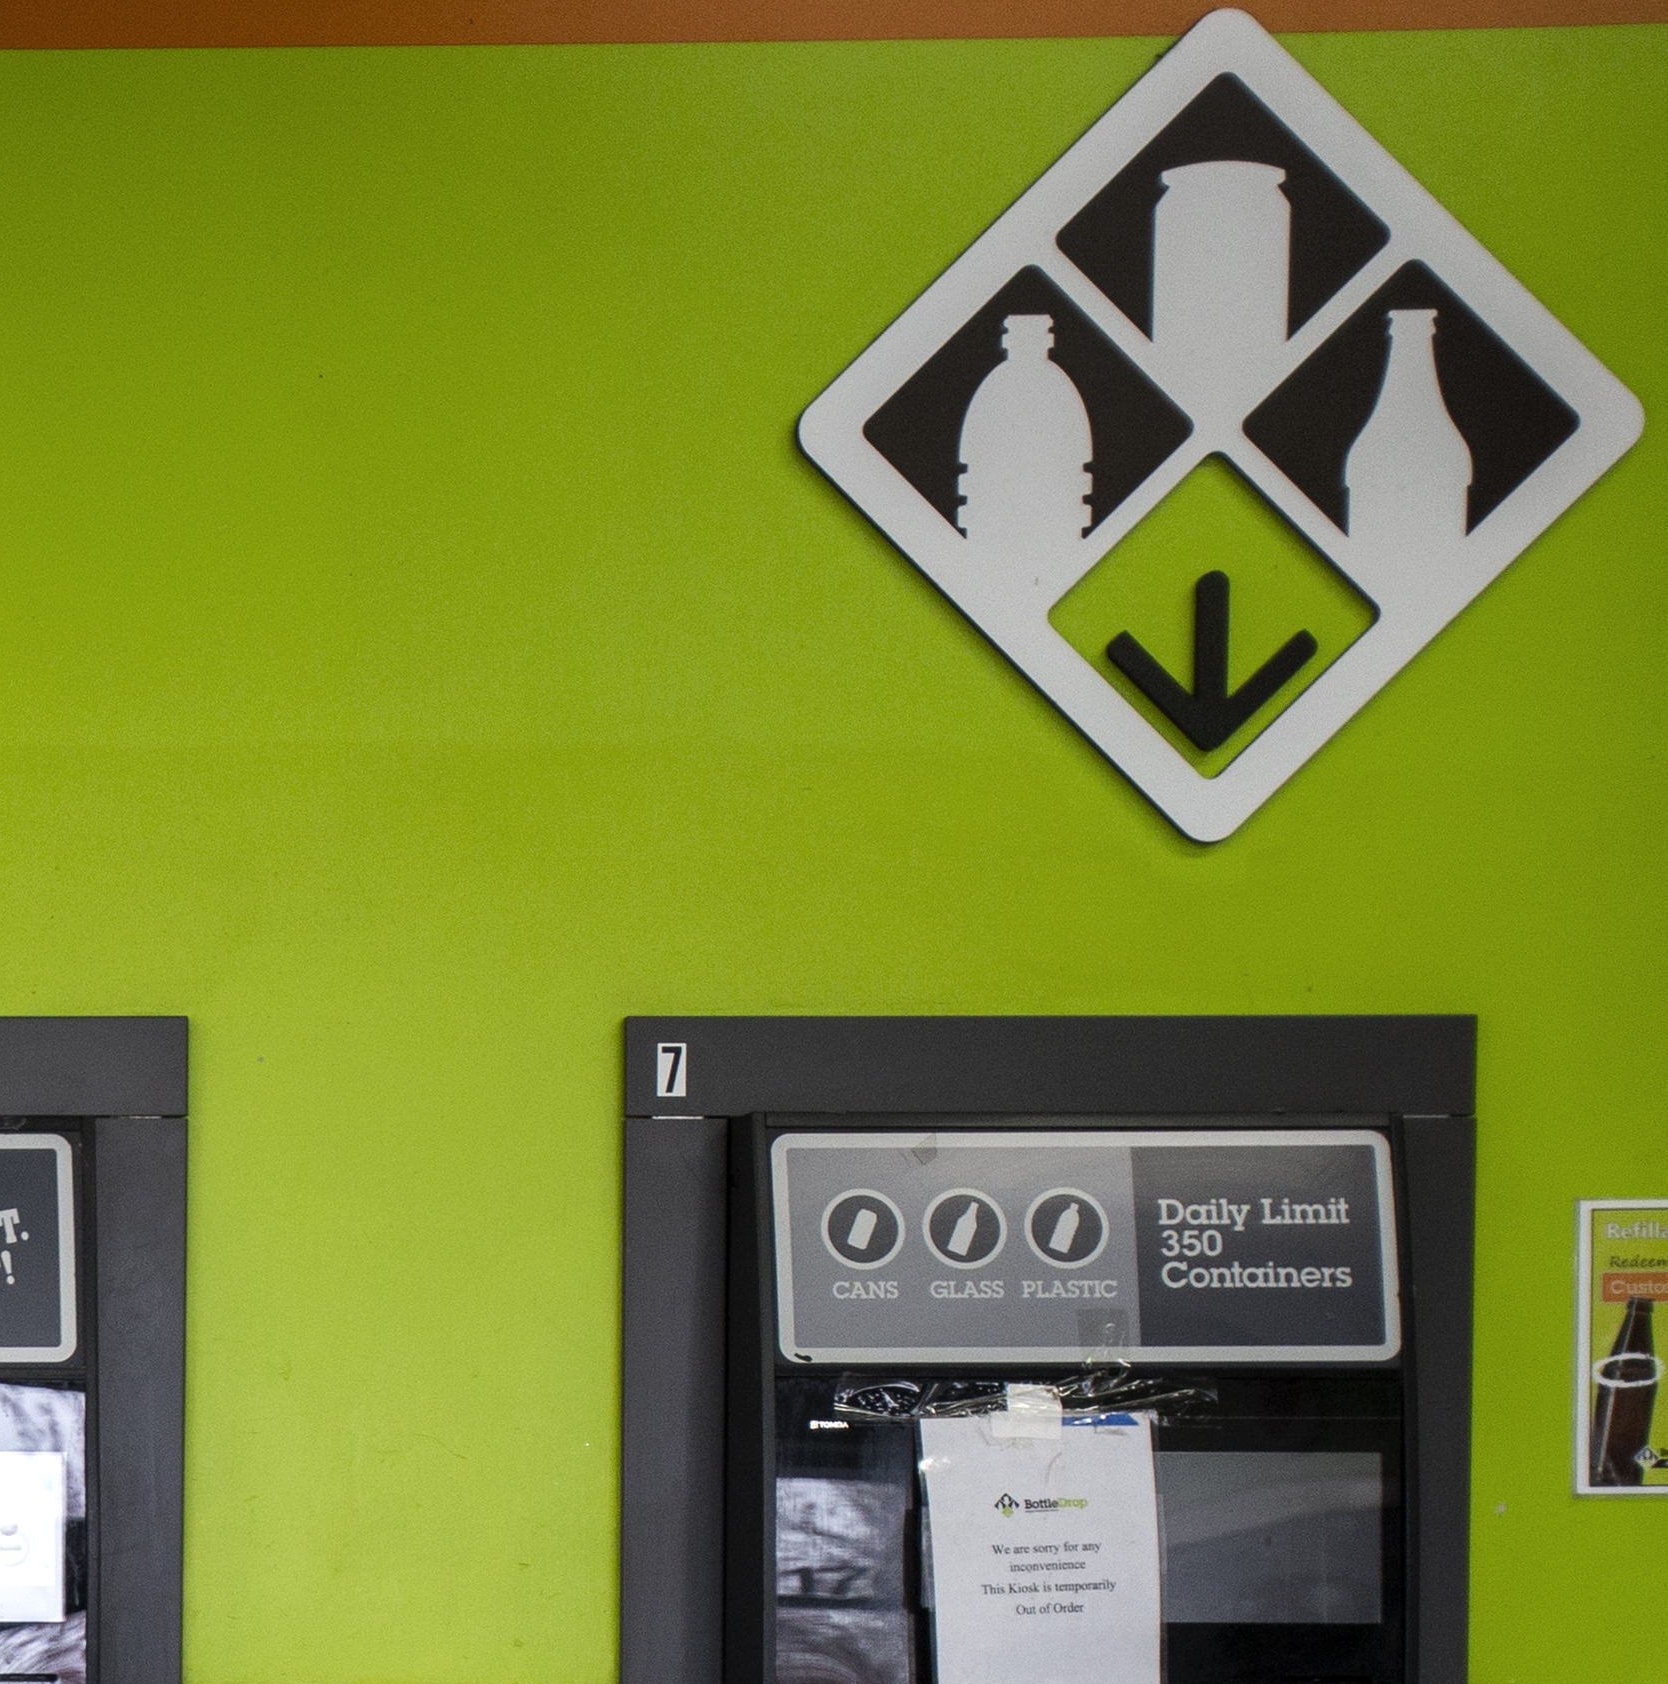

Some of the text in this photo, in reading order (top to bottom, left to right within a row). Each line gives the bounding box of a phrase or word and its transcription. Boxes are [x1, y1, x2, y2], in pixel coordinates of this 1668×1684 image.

[661, 1045, 683, 1094] 7
[1156, 1196, 1351, 1232] Daily Limit
[1160, 1229, 1224, 1258] 350
[1160, 1260, 1354, 1290] Containers
[832, 1279, 1119, 1300] CANS GLASS PLASTIC
[1024, 1497, 1088, 1510] BottleDrop
[991, 1541, 1102, 1557] We are sorry for any
[1009, 1559, 1087, 1574] inconvenience
[981, 1578, 1117, 1596] This Kiosk is temporarily
[1016, 1602, 1084, 1616] Out of Order
